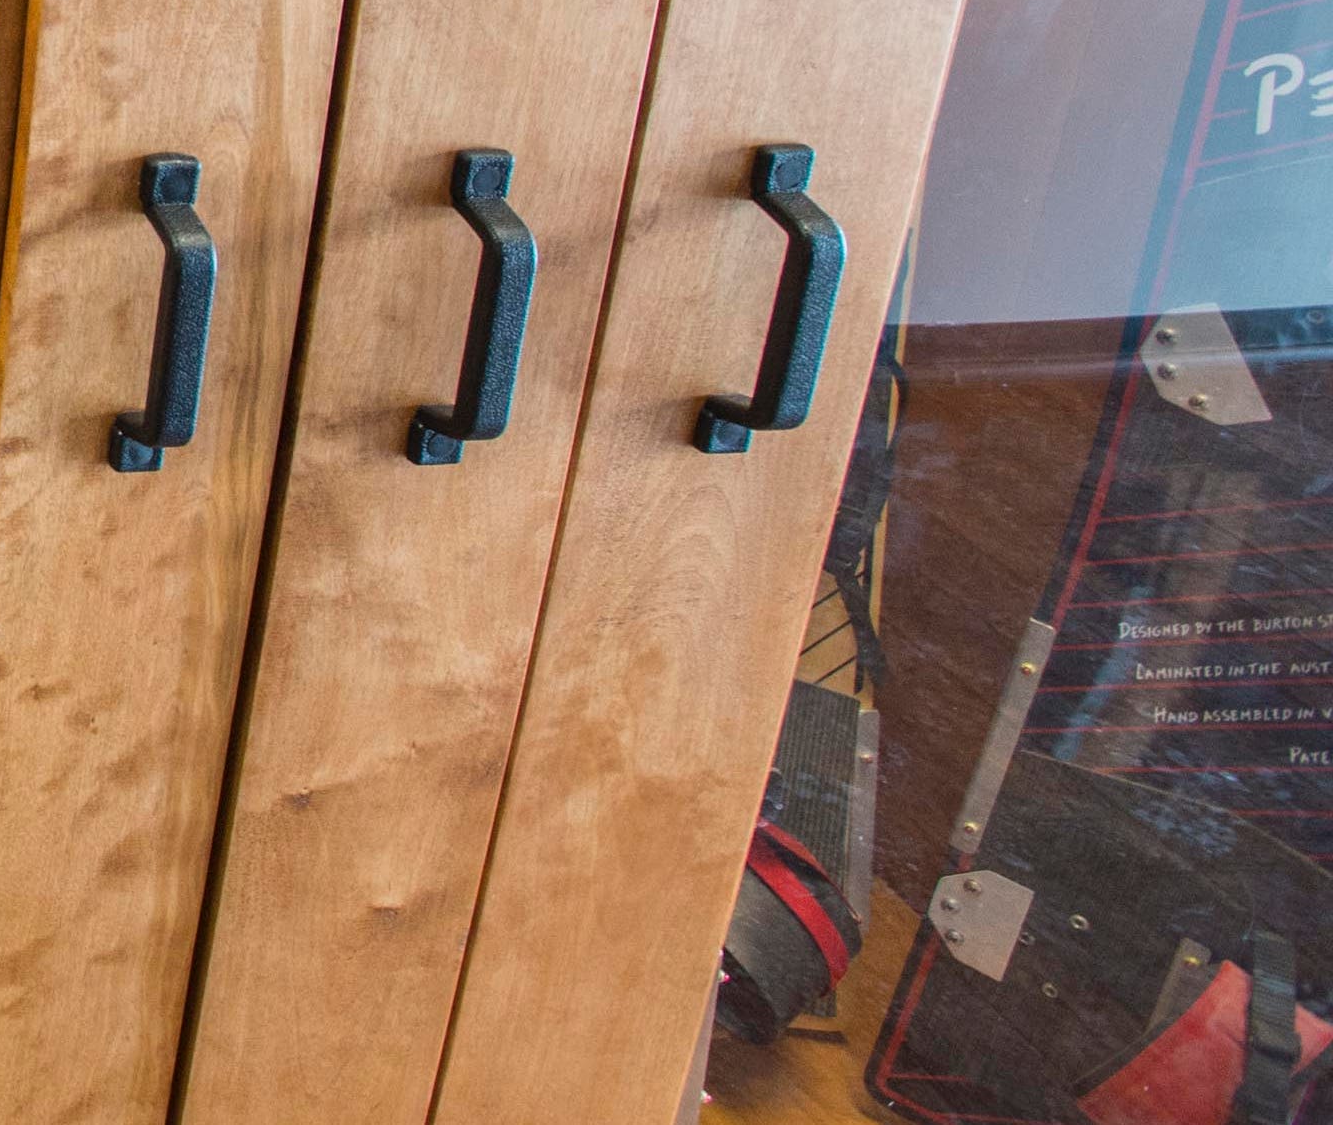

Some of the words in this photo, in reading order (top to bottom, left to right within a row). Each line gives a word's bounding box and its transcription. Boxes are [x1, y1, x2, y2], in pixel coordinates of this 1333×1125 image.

[1118, 621, 1190, 640] DESIGNED
[1195, 620, 1213, 635] BY
[1218, 620, 1246, 633] THE
[1252, 615, 1313, 632] BURTON
[1135, 662, 1223, 681] LAMINATED
[1228, 663, 1245, 677] IN
[1247, 662, 1282, 676] THE
[1153, 705, 1199, 724] HAND
[1202, 706, 1291, 723] ASSEMBLED
[1297, 707, 1314, 720] IN
